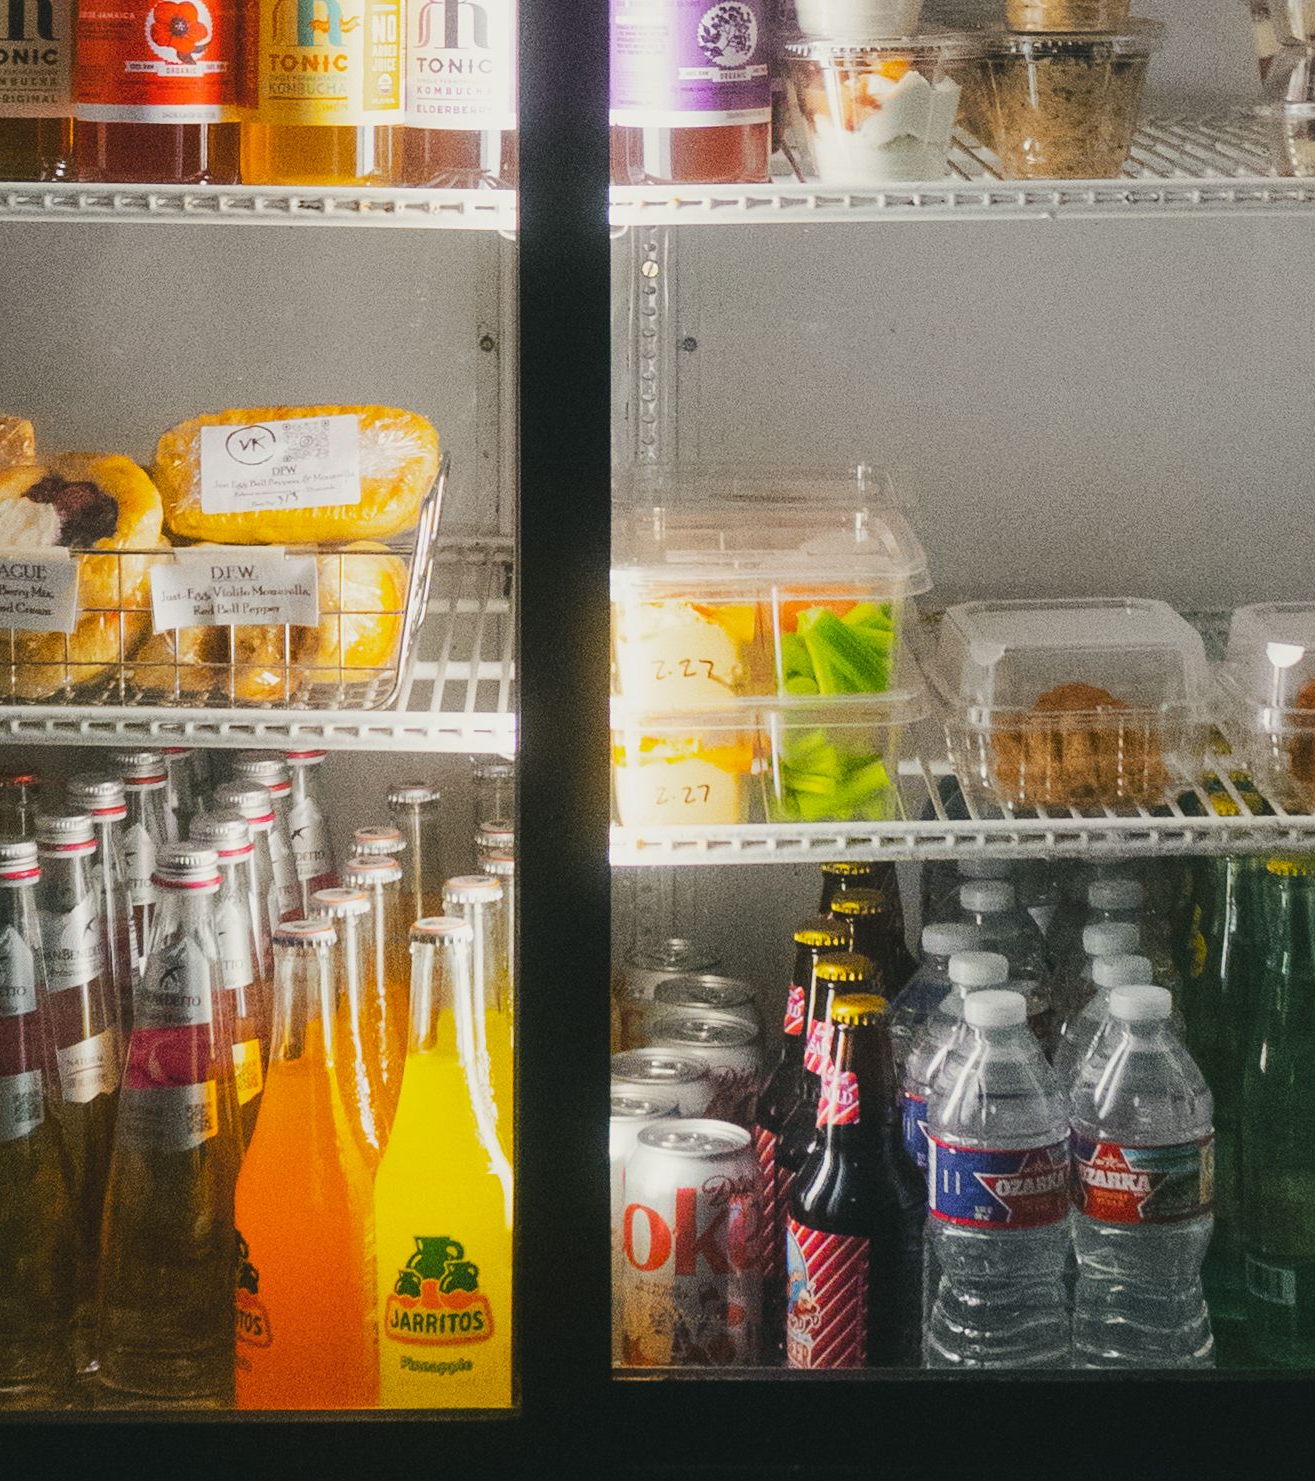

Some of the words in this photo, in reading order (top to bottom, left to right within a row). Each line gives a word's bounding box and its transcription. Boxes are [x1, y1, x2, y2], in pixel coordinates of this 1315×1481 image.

[268, 53, 349, 73] TONIC
[417, 56, 494, 75] TONIC
[390, 1307, 485, 1336] JARRITOS
